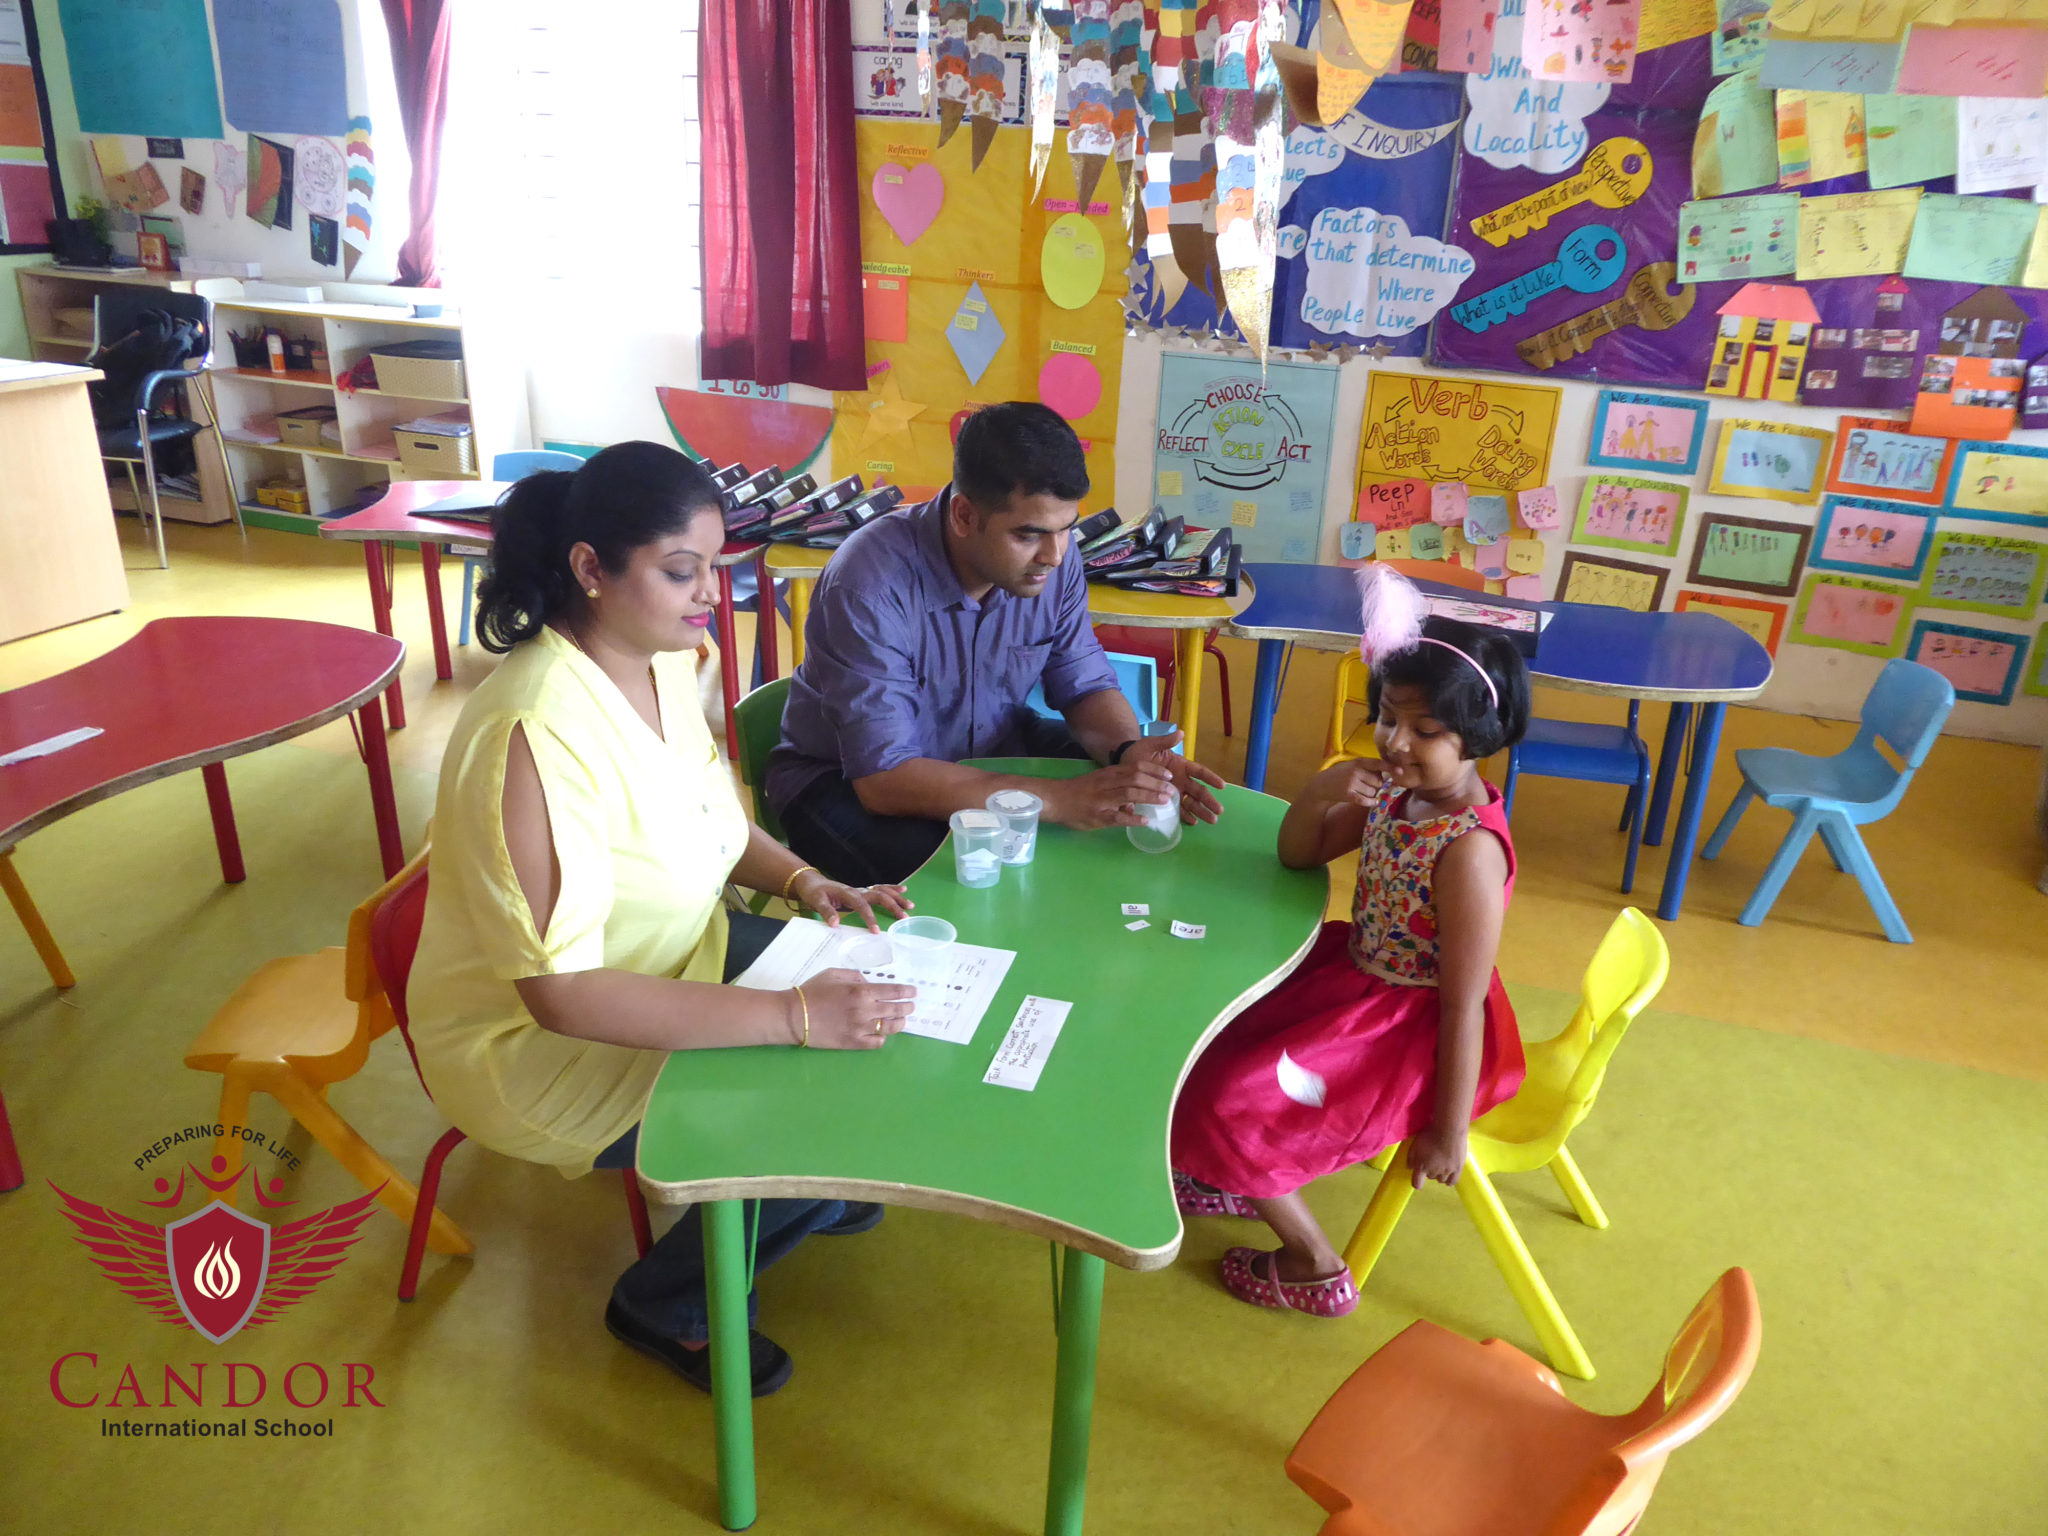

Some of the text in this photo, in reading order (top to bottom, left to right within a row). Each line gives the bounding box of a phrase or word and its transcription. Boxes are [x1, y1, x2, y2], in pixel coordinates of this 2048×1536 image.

[873, 56, 903, 69] carng
[1513, 84, 1564, 114] And
[887, 144, 928, 156] Reflective
[1351, 124, 1438, 156] INQUIRY
[1473, 119, 1585, 165] Locality
[1045, 199, 1067, 212] Open
[1320, 209, 1397, 239] Factors
[1311, 238, 1473, 274] that determine
[1567, 238, 1601, 280] Form
[958, 268, 994, 280] Thinkers
[1378, 276, 1435, 302] Where
[1303, 296, 1417, 331] People Live
[1455, 297, 1490, 325] What
[1494, 295, 1506, 310] is
[1508, 283, 1524, 303] it
[1052, 341, 1093, 354] Balanced
[1207, 383, 1267, 409] CHOOSE
[1411, 377, 1488, 421] Verb
[1213, 407, 1265, 439] ACTION
[1157, 429, 1312, 460] REFLECT ACT
[1221, 440, 1265, 460] CYCLE
[1365, 419, 1538, 479] Action Doing
[866, 461, 893, 472] Caring
[1379, 444, 1520, 491] Words Words
[1391, 501, 1405, 512] in
